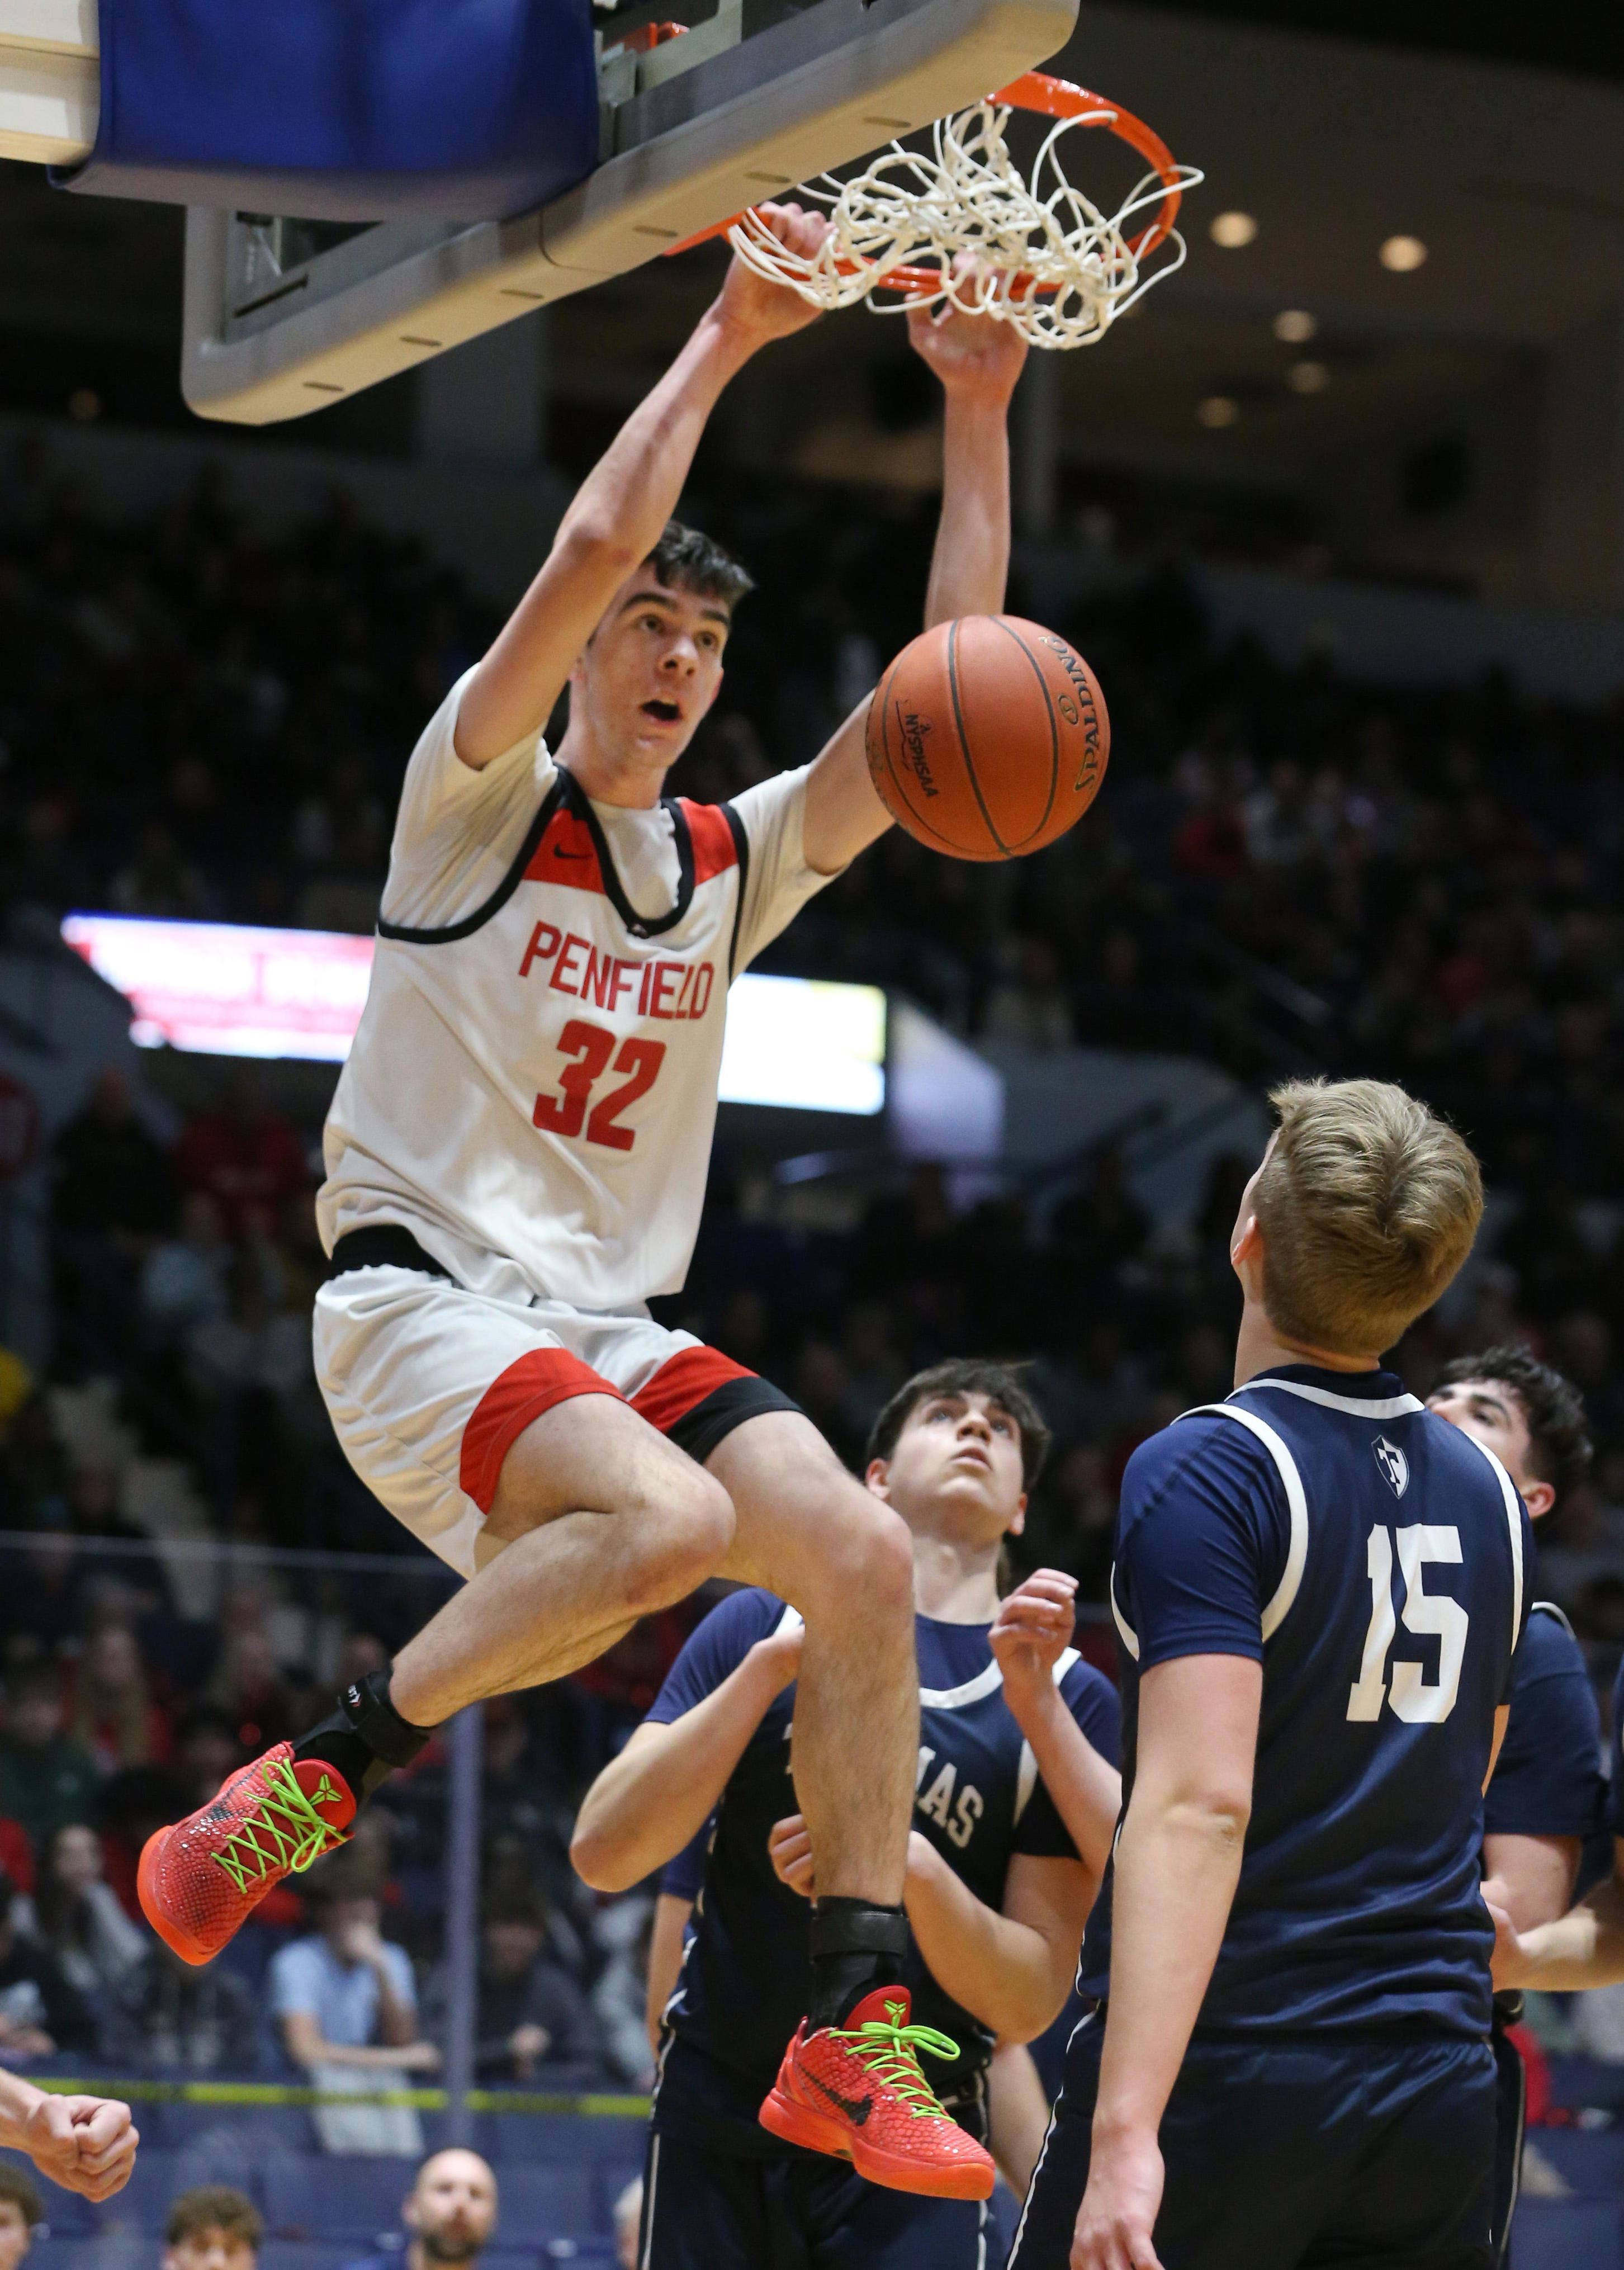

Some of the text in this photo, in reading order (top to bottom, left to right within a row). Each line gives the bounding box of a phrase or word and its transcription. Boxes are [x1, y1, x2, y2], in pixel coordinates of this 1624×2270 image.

[905, 714, 939, 798] NYSPHSAA
[1038, 635, 1100, 792] SPALDING
[518, 920, 715, 1020] PENFIELD
[533, 1019, 667, 1151] 32
[1346, 1523, 1469, 1723] 15
